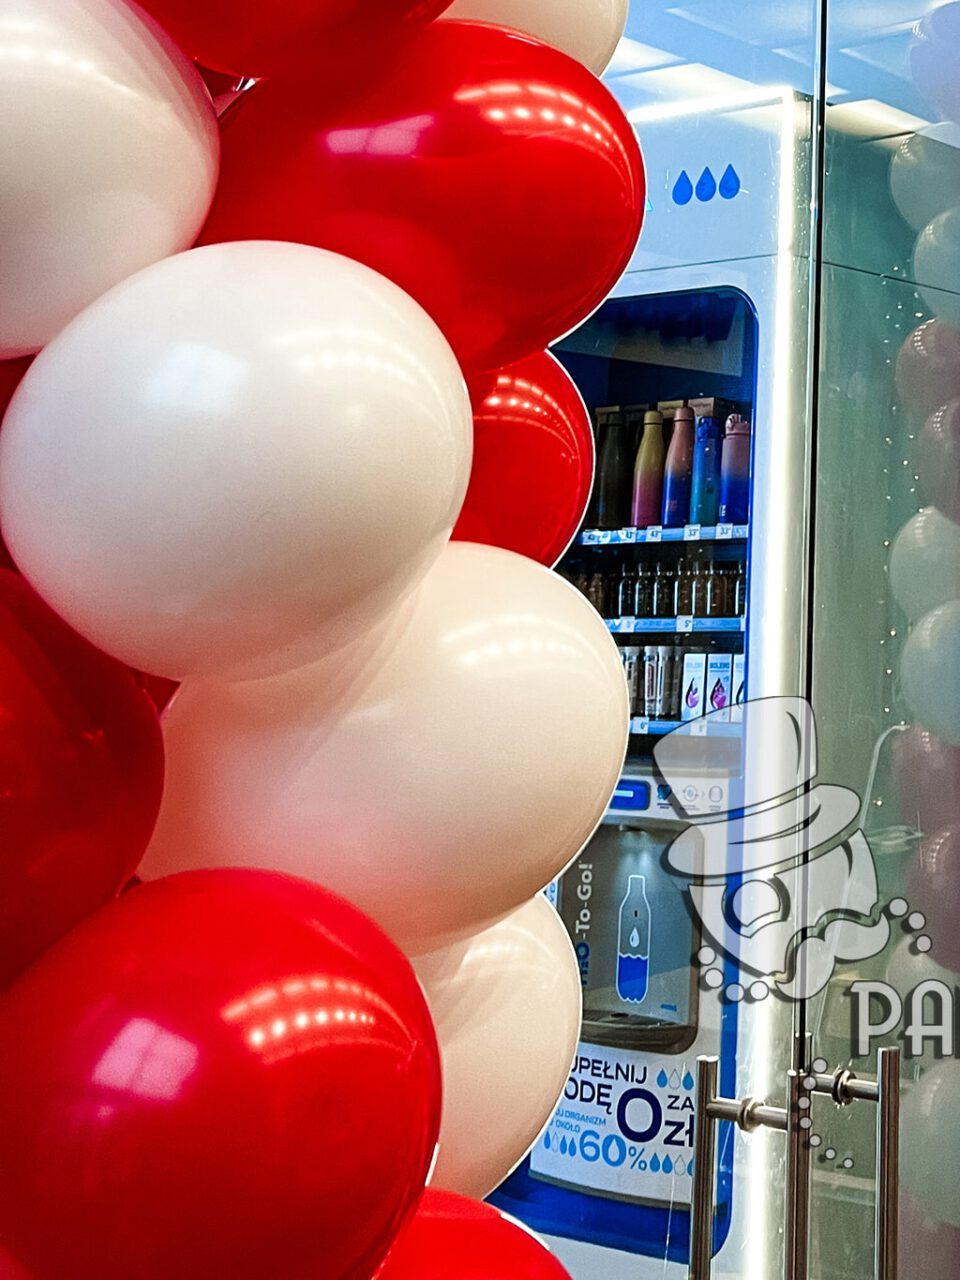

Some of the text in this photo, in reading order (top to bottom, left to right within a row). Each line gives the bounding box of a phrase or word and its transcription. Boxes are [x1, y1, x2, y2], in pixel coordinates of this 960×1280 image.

[564, 1077, 612, 1114] ODĘ
[666, 1094, 695, 1112] ZA
[579, 1129, 647, 1171] 60%
